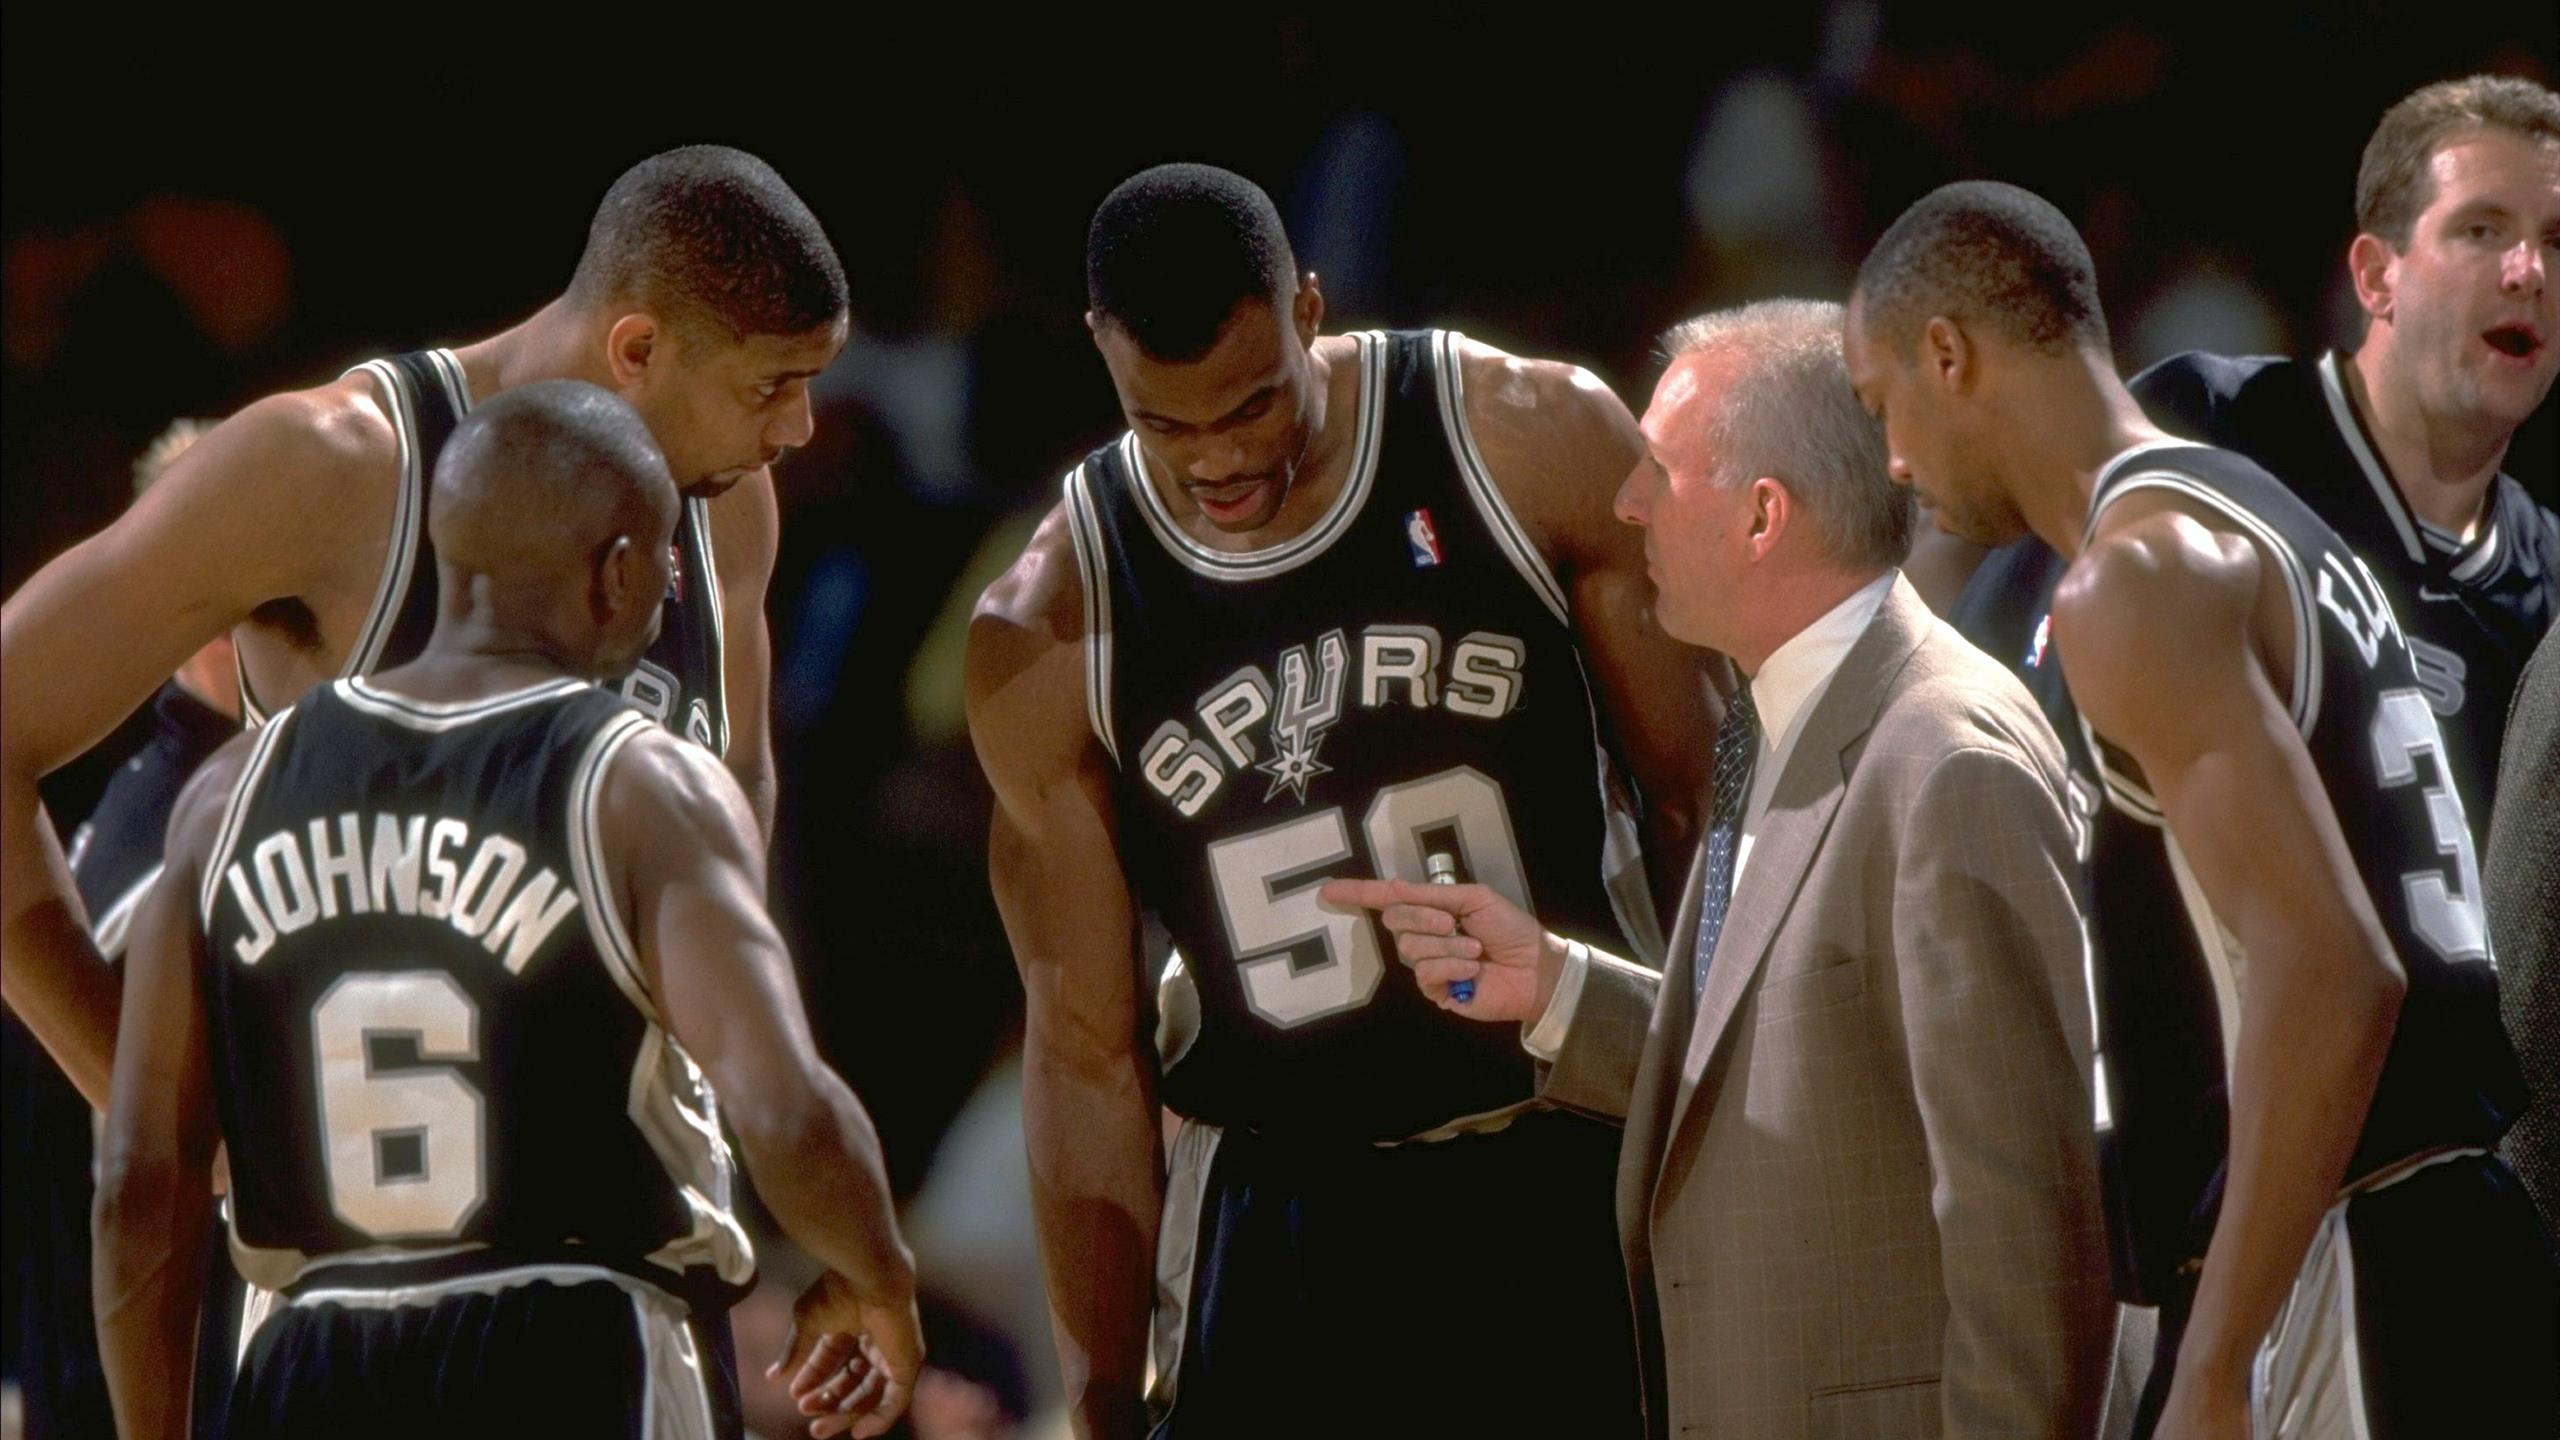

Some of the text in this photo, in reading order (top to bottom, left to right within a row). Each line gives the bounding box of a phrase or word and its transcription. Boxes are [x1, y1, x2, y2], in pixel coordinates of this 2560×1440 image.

[1139, 624, 1526, 817] SPURS
[2368, 687, 2496, 971] 3
[226, 811, 579, 975] JOHNSON
[1206, 764, 1537, 1030] 50
[311, 969, 487, 1239] 6
